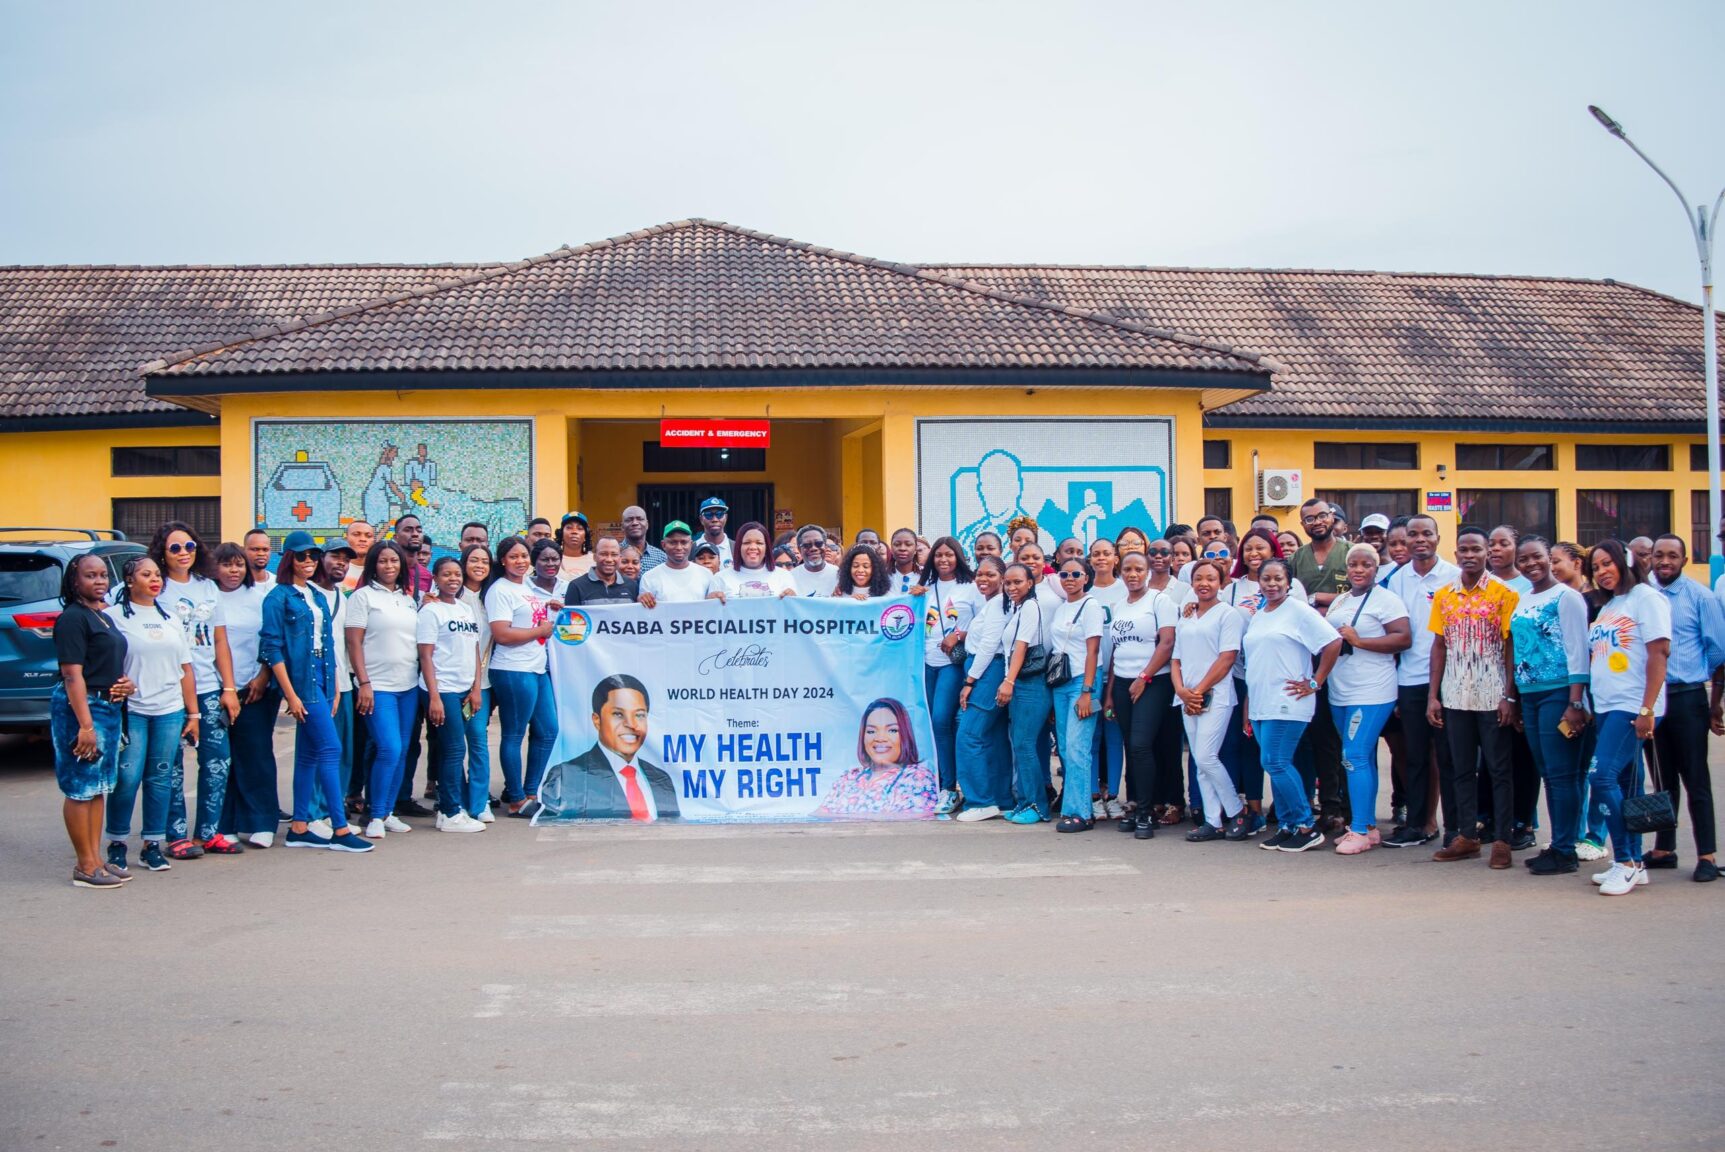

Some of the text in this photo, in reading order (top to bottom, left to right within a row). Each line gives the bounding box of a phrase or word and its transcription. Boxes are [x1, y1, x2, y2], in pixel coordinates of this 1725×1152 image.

[596, 620, 664, 635] ASABA
[670, 619, 777, 635] SPECIALIST
[783, 619, 879, 635] HOSPITAL
[1112, 619, 1135, 631] King
[698, 644, 773, 675] Celebrates
[667, 687, 834, 700] WORLD HEALTH DAY 2024
[727, 718, 760, 728] Theme:
[663, 732, 822, 763] MY HEALTH
[682, 767, 821, 799] MY RIGHT
